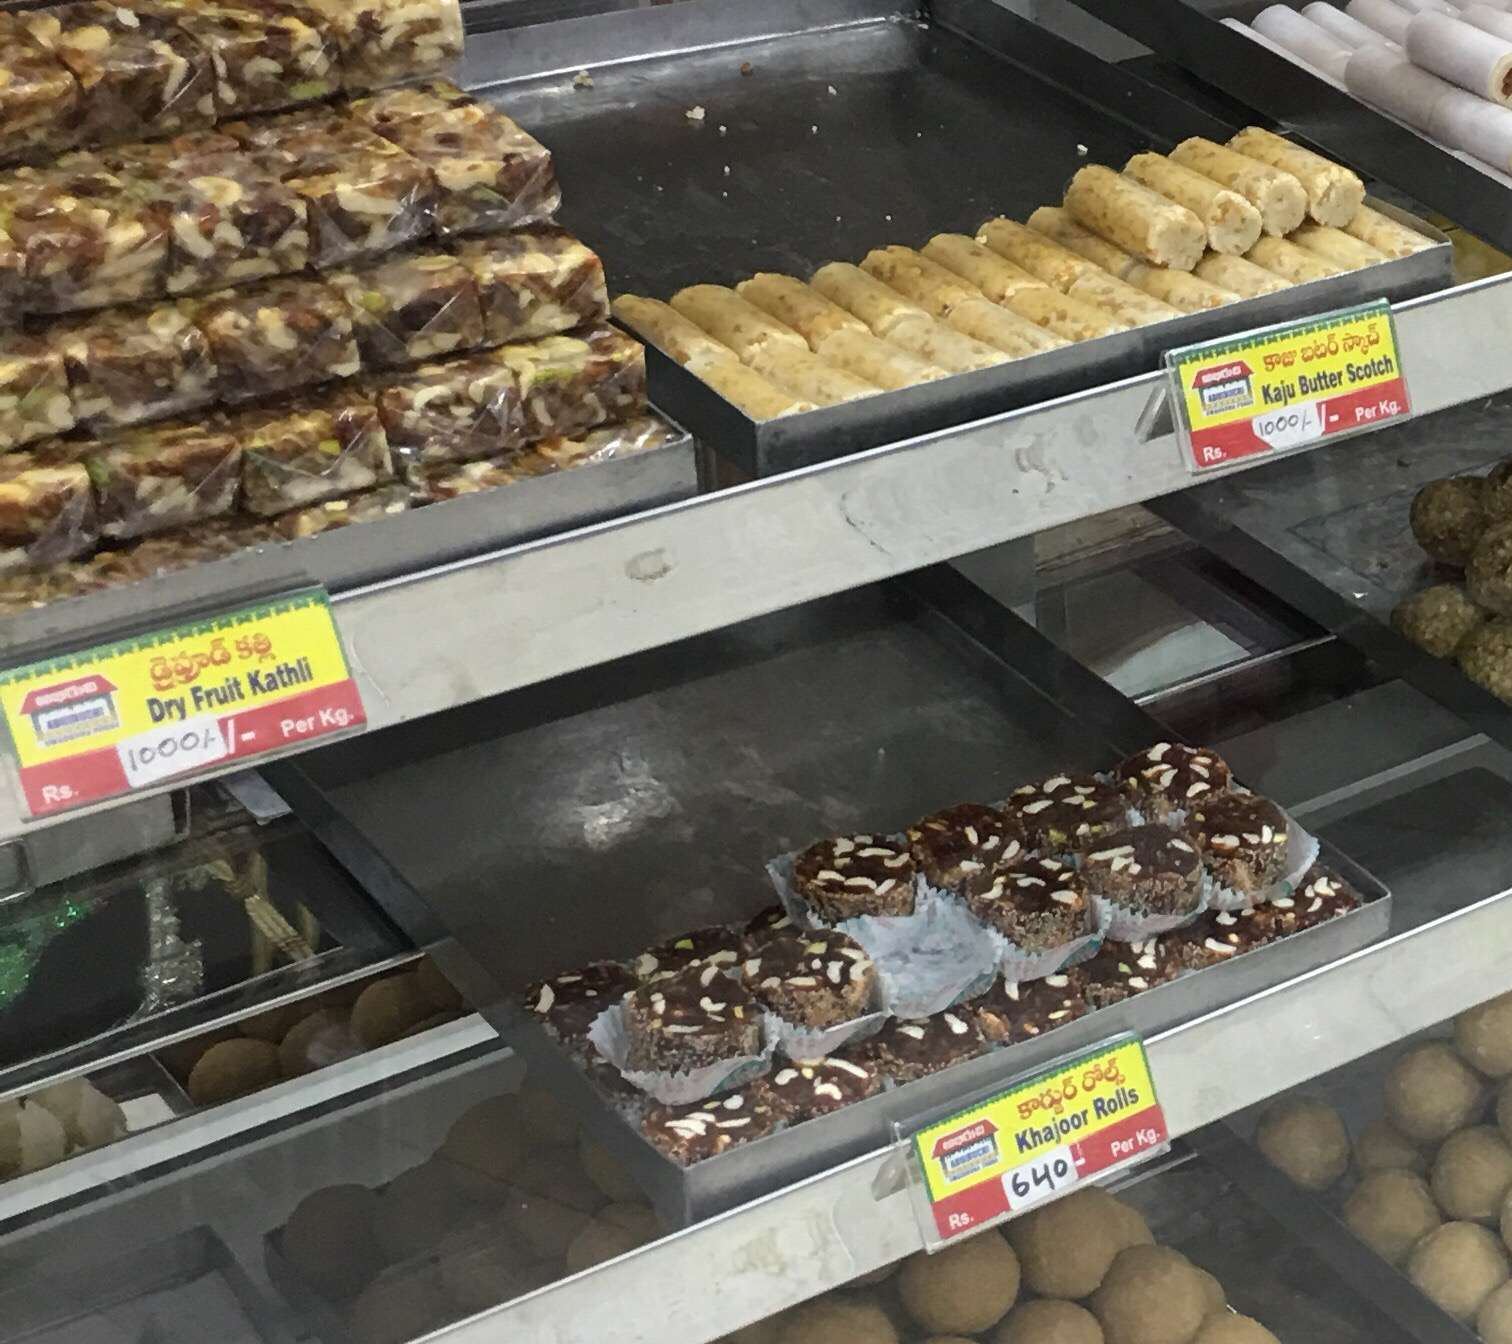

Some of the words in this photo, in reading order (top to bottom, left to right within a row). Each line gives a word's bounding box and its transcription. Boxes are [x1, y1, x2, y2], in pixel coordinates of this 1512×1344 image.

[1262, 380, 1295, 405] Kaju
[1299, 369, 1343, 392] Butter
[1347, 355, 1394, 381] Scotch
[1203, 446, 1227, 462] Rs.
[1355, 407, 1376, 421] Per
[1380, 400, 1401, 416] Kg.
[147, 697, 186, 722] Dry
[191, 677, 245, 711] Fruit
[249, 657, 314, 696] Kathli
[42, 783, 79, 803] Rs.
[281, 713, 315, 738] Per
[321, 706, 355, 731] Kg.
[1015, 1109, 1088, 1153] Khajoor
[1093, 1087, 1139, 1120] Rolls
[949, 1212, 974, 1230] Rs.
[1011, 1159, 1068, 1197] 640
[1111, 1139, 1133, 1157] Per
[1136, 1128, 1160, 1148] Kg.
